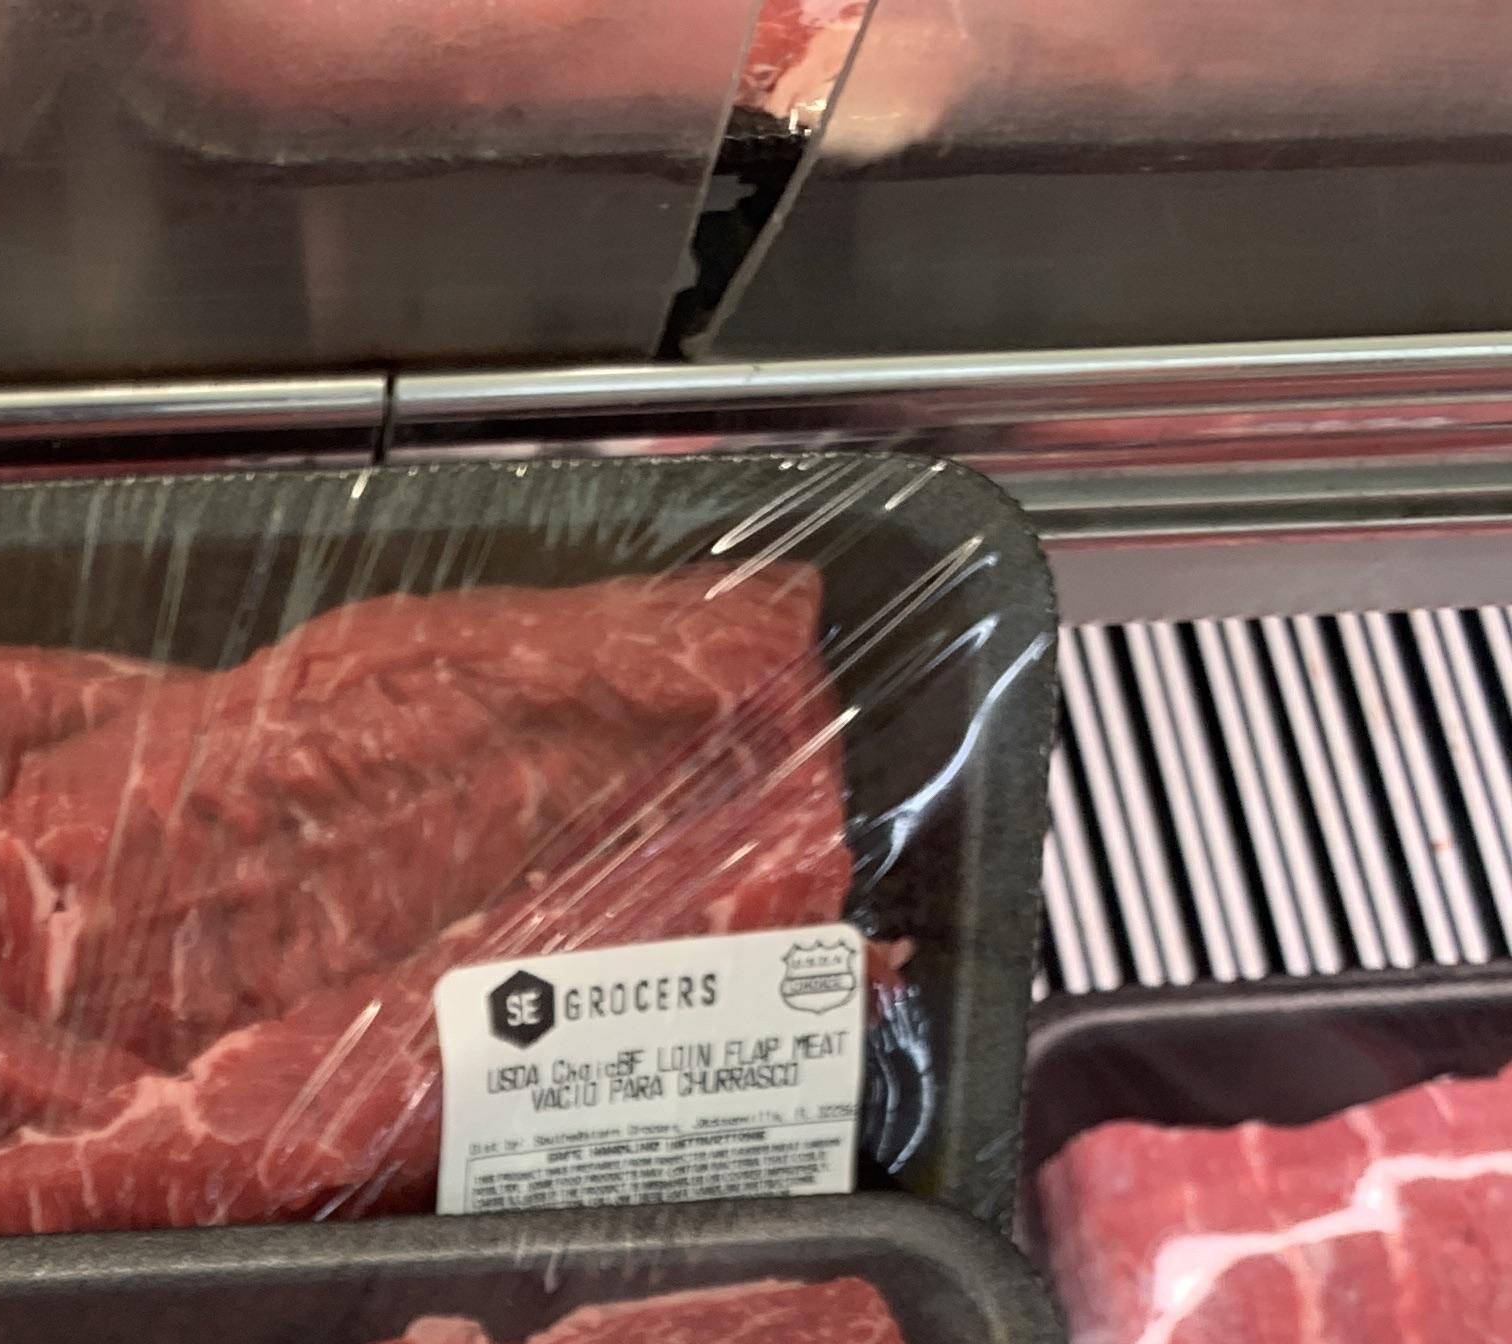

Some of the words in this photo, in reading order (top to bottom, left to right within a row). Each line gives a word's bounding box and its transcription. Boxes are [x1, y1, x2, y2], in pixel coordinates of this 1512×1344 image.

[506, 992, 541, 1026] SE
[565, 973, 718, 1020] GROCERS
[488, 1065, 539, 1095] USDA
[657, 1044, 710, 1072] LOIN
[724, 1038, 780, 1066] FLAP
[791, 1031, 847, 1060] MEAT
[532, 1080, 597, 1111] VACIO
[609, 1075, 664, 1101] PARA
[678, 1063, 798, 1095] CHURRASCO
